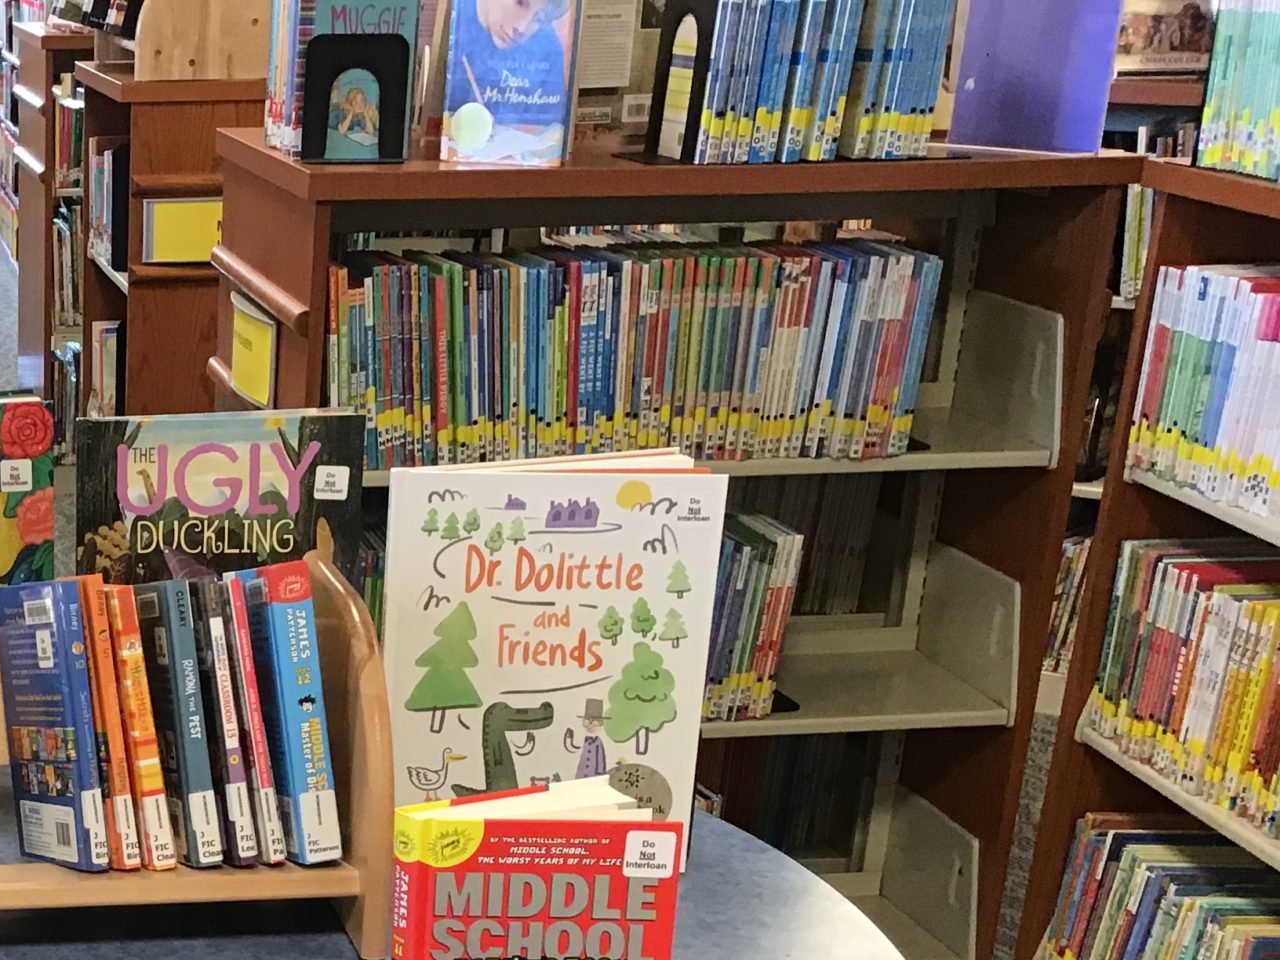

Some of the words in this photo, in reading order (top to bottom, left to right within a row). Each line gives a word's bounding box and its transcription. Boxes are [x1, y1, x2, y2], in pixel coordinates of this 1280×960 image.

[501, 70, 529, 87] Dear
[504, 88, 560, 104] Henshaw
[132, 447, 155, 464] THE
[117, 440, 321, 517] UGLY
[137, 518, 295, 554] DUCKLING
[465, 543, 502, 593] Dr.
[514, 546, 644, 592] Dolittle
[176, 591, 187, 627] CLEARY
[534, 605, 570, 629] and
[287, 608, 298, 663] PATTERSON
[296, 609, 311, 659] JAMES
[497, 623, 603, 672] Friends
[182, 659, 196, 695] RAMONA
[188, 715, 201, 739] PEST
[310, 717, 325, 769] MIDDLE
[310, 845, 339, 853] Patterson
[639, 851, 656, 860] Not
[642, 840, 655, 848] Do
[477, 856, 495, 864] THE
[498, 856, 531, 864] WORST
[534, 857, 564, 865] YEARS
[567, 857, 579, 865] OF
[600, 858, 622, 866] LIFE
[626, 861, 667, 870] Interloan
[434, 871, 659, 920] MIDDLE
